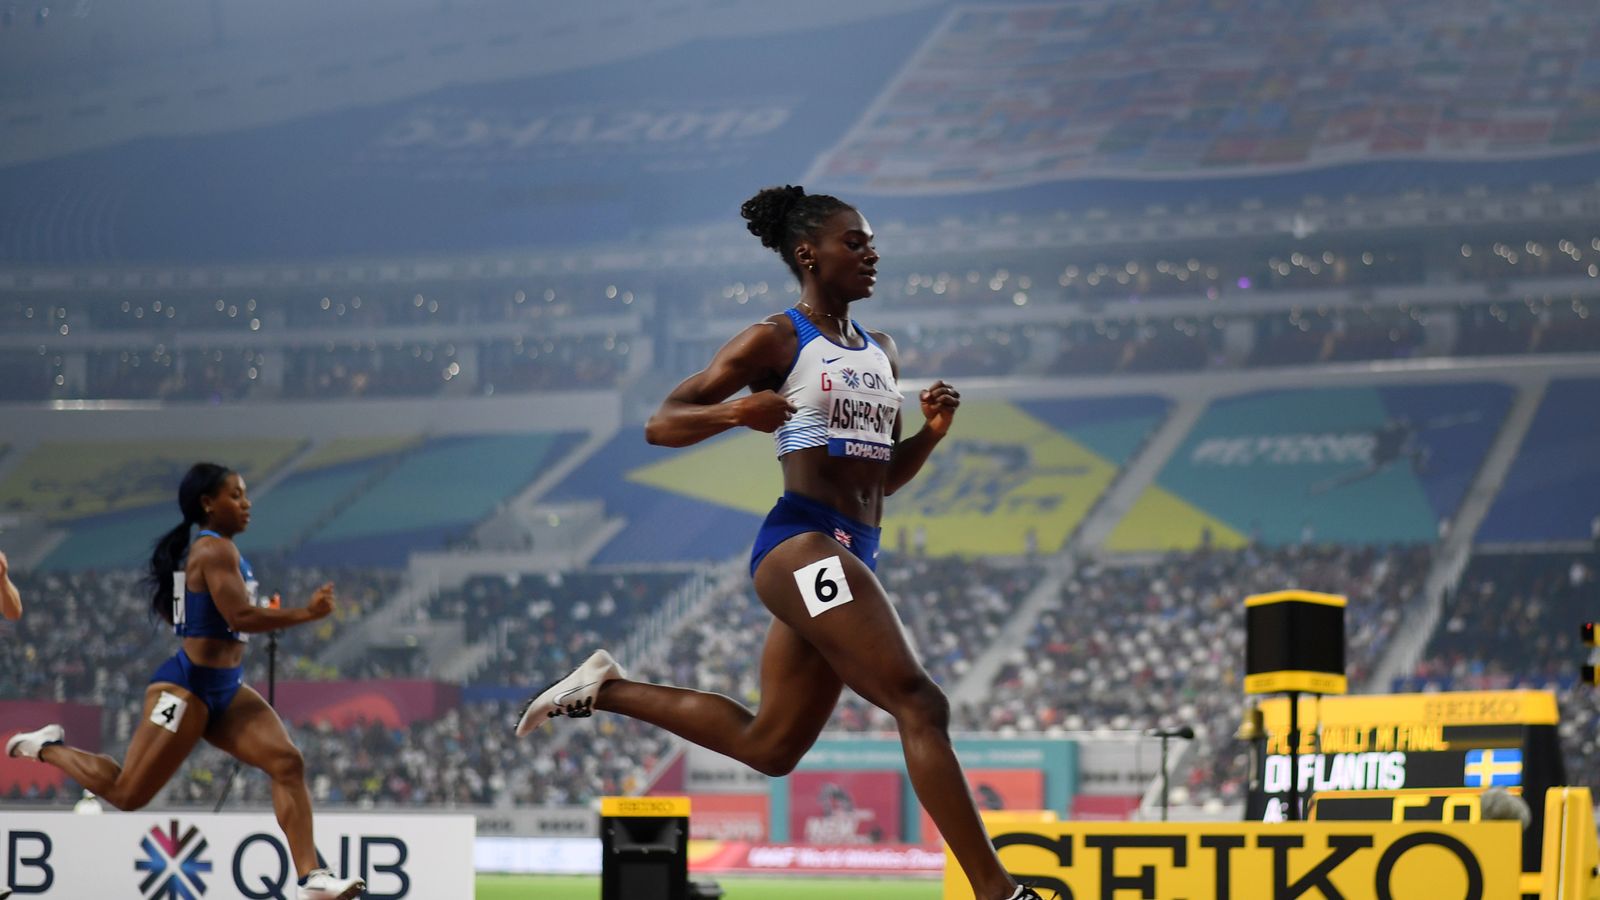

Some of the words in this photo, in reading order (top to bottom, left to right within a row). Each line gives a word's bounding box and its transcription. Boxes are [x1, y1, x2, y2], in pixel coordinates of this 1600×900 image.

[862, 372, 894, 393] QN
[814, 567, 838, 603] 6
[161, 703, 177, 723] 4
[991, 831, 1484, 900] SEIKO
